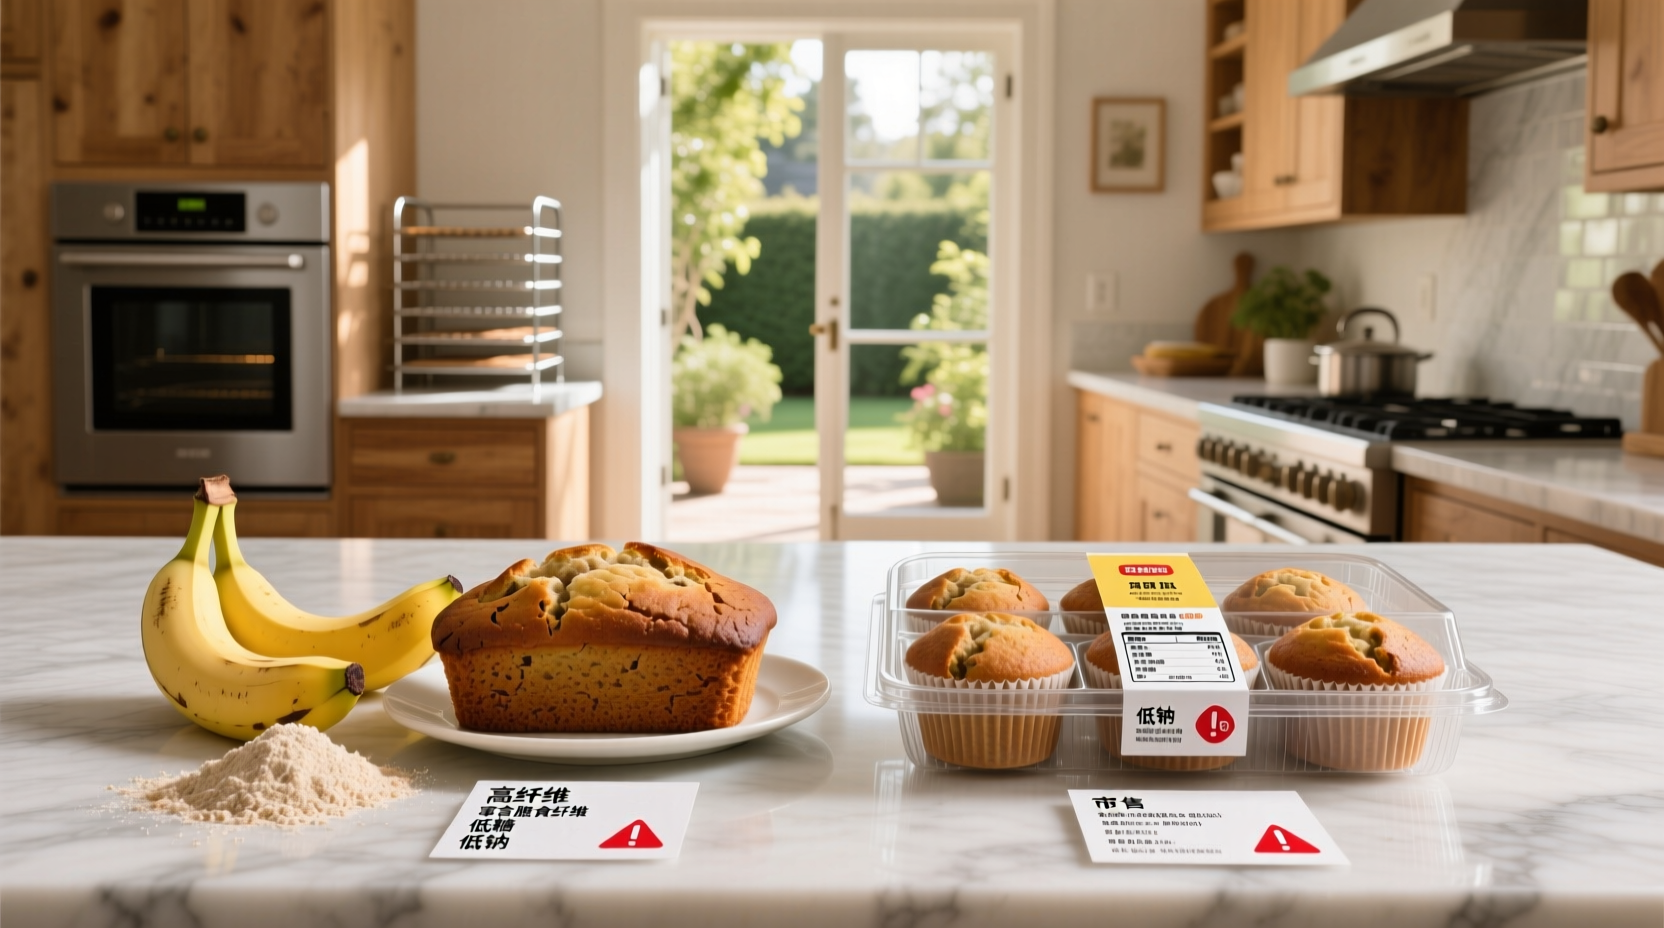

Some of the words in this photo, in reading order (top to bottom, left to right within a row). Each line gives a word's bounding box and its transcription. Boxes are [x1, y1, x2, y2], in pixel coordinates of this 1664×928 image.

[1136, 705, 1175, 725] 低钠
[486, 786, 571, 804] 高纤维
[459, 832, 510, 850] 低钠
